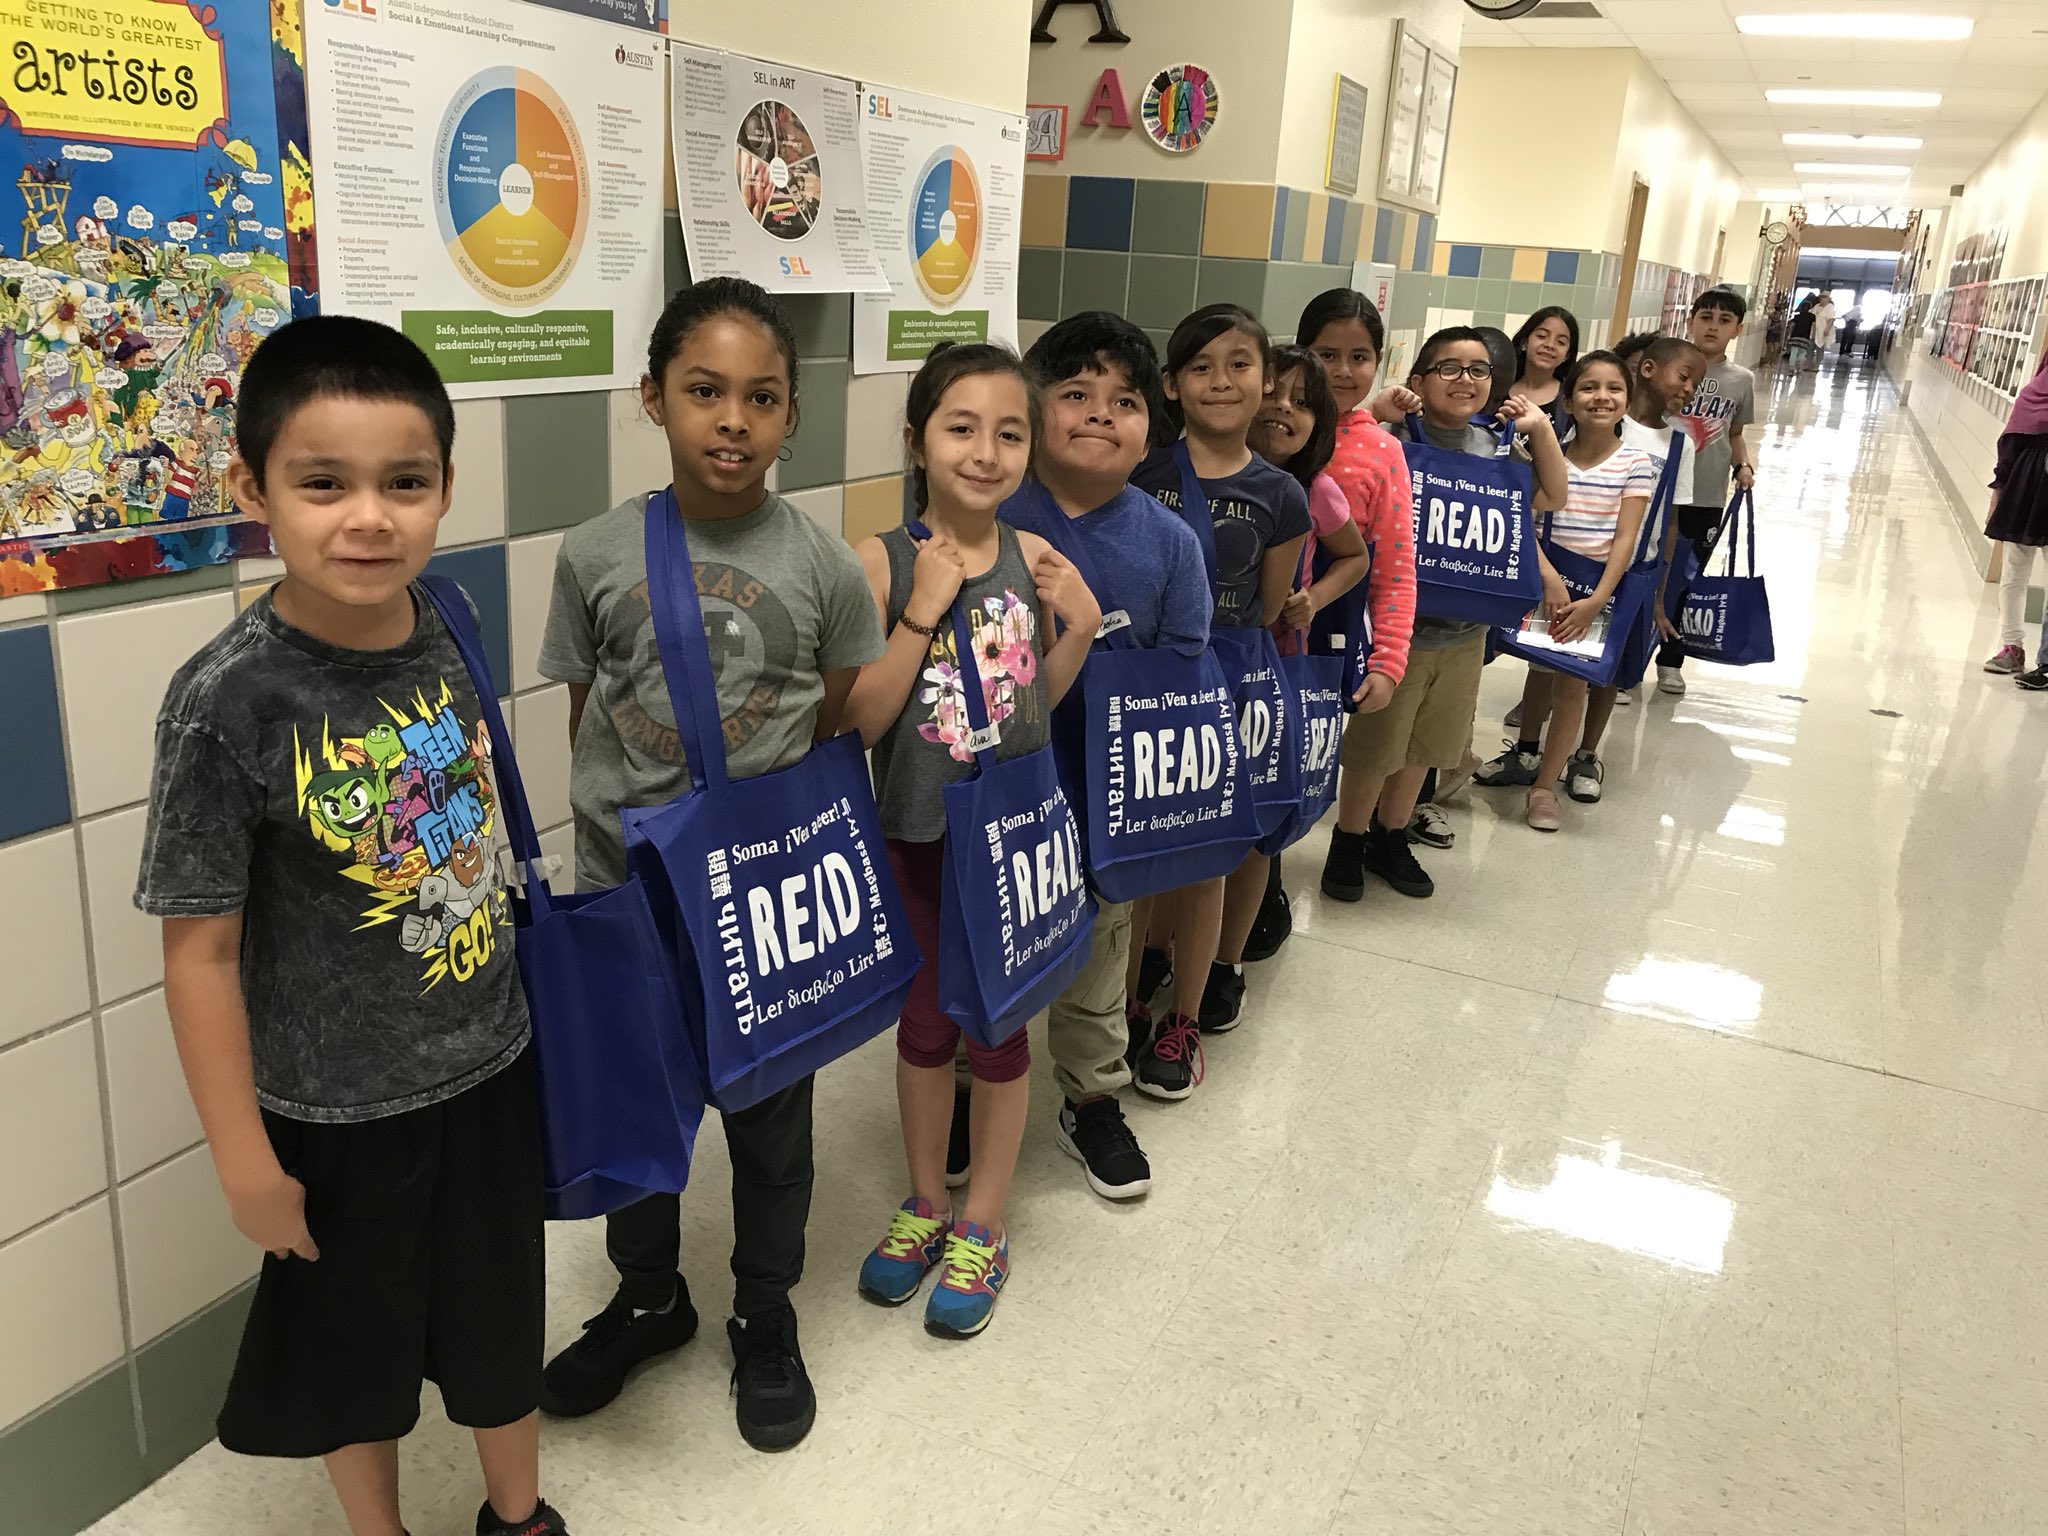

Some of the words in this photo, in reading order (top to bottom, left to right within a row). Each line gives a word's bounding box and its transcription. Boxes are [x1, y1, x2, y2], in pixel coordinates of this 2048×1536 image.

[26, 1, 98, 21] GETTING
[104, 11, 124, 25] TO
[131, 16, 178, 33] KNOW
[388, 11, 413, 24] Social
[424, 19, 464, 34] Emotional
[466, 27, 500, 42] Learning
[414, 1, 462, 20] Independent
[463, 13, 487, 26] School
[489, 20, 514, 31] District
[0, 12, 35, 29] THE
[40, 17, 115, 40] WORLD'S
[121, 30, 202, 52] GREATEST
[328, 39, 364, 53] Responsible
[626, 53, 654, 67] AUSTIN
[12, 40, 199, 111] artists
[754, 71, 768, 86] SEL
[770, 74, 778, 87] in
[779, 76, 795, 90] ART
[868, 94, 892, 118] SEL
[1080, 67, 1132, 129] A
[1172, 92, 1192, 124] A
[462, 131, 488, 142] Executive
[462, 142, 489, 153] Functions
[459, 164, 491, 175] Responsible
[469, 155, 480, 163] and
[454, 174, 498, 187] Decision-Making
[503, 184, 531, 195] LEARNER
[779, 256, 812, 276] SEL
[457, 256, 474, 279] SENSE
[473, 275, 482, 286] OF
[514, 291, 539, 302] CULTURAL
[436, 324, 459, 337] Safe,
[461, 324, 503, 336] inclusive,
[504, 323, 544, 336] culturally
[545, 322, 589, 335] responsive,
[435, 339, 496, 351] academically
[497, 338, 538, 351] engaging,
[539, 338, 554, 348] and
[555, 336, 590, 349] equitable
[470, 354, 507, 366] learning
[508, 351, 562, 363] environments
[66, 419, 90, 439] SOUP
[1426, 474, 1452, 488] Soma
[1455, 479, 1476, 494] ¡Ven
[1479, 486, 1485, 494] a
[1486, 485, 1508, 499] leer!
[1226, 501, 1257, 524] ALL,
[1426, 497, 1505, 554] READ
[1418, 554, 1437, 567] Ler
[1440, 557, 1481, 576] διαβαζω
[1484, 565, 1504, 578] Lire
[1217, 591, 1240, 608] ALL.
[1125, 695, 1158, 711] Soma
[1161, 692, 1188, 711] ¡Ven
[1191, 695, 1198, 705] a
[399, 706, 467, 776] TEEN
[1222, 722, 1238, 777] Magbasá
[1133, 724, 1221, 800] READ
[1108, 737, 1125, 837] читать
[1001, 810, 1035, 834] Soma
[1150, 810, 1195, 831] διαβαζω
[1196, 806, 1218, 822] Lire
[1126, 818, 1147, 834] Ler
[731, 839, 780, 865] Soma
[854, 840, 882, 909] Magbasá
[747, 852, 861, 977] READ
[996, 864, 1015, 976] читать
[450, 902, 496, 983] GO!
[717, 901, 756, 1035] читать
[848, 951, 875, 978] Lire
[1016, 946, 1032, 967] Ler
[755, 998, 783, 1024] Ler
